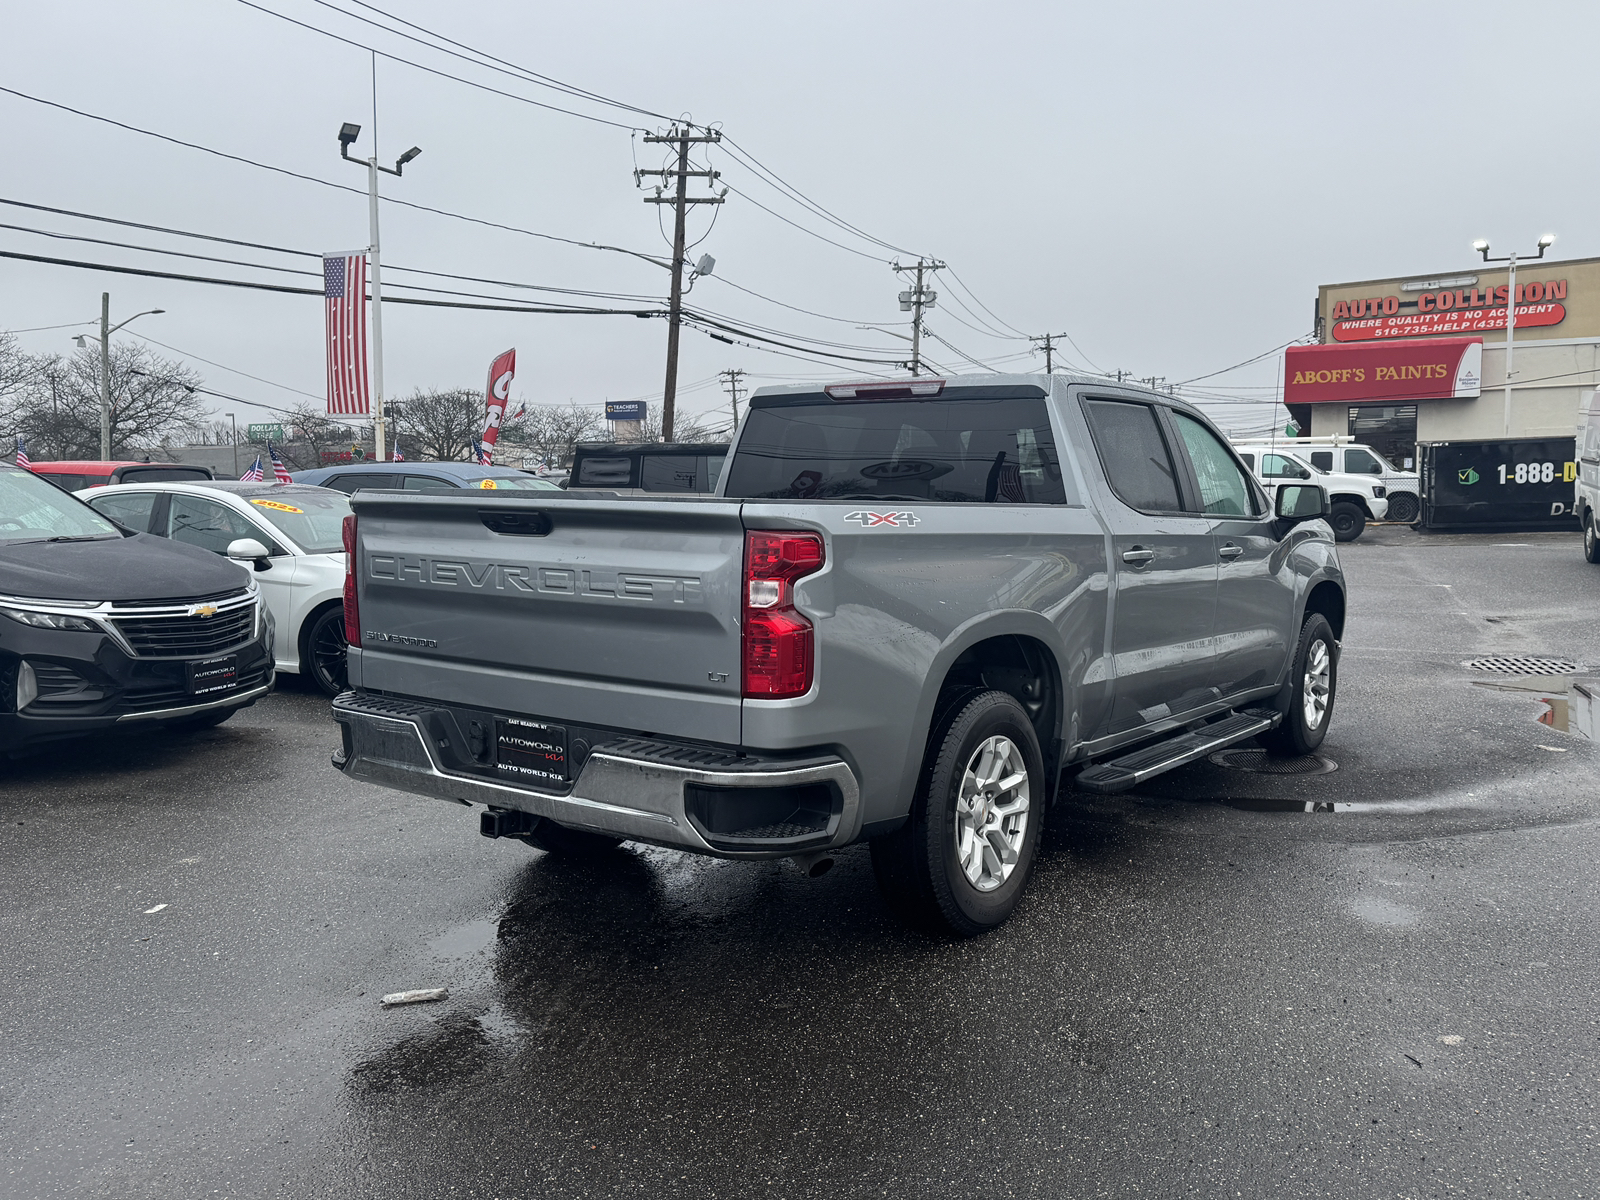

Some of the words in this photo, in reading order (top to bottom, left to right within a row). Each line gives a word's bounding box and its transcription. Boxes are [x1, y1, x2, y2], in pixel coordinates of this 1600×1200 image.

[1332, 296, 1399, 319] AUTO
[1418, 279, 1567, 312] COLLISION
[1342, 319, 1382, 330] WHERE
[1388, 314, 1440, 326] QUALITY
[1446, 312, 1458, 320] IS
[1464, 310, 1482, 319] NO
[1488, 304, 1555, 317] ACIDENT
[1375, 321, 1470, 336] 516-735-HELP
[1292, 368, 1366, 384] ABOFF'S
[1375, 364, 1447, 381] PAINTS
[257, 501, 298, 512] 2024
[371, 555, 701, 603] CHEVROLET
[366, 630, 438, 648] SILVERADO
[194, 667, 235, 678] AUTOWORLD
[708, 671, 729, 683] LT
[498, 735, 563, 754] AUTOWORLD
[545, 753, 564, 762] KIA
[497, 763, 518, 772] AUTO
[520, 767, 547, 777] WORLD
[549, 773, 563, 781] KIA
